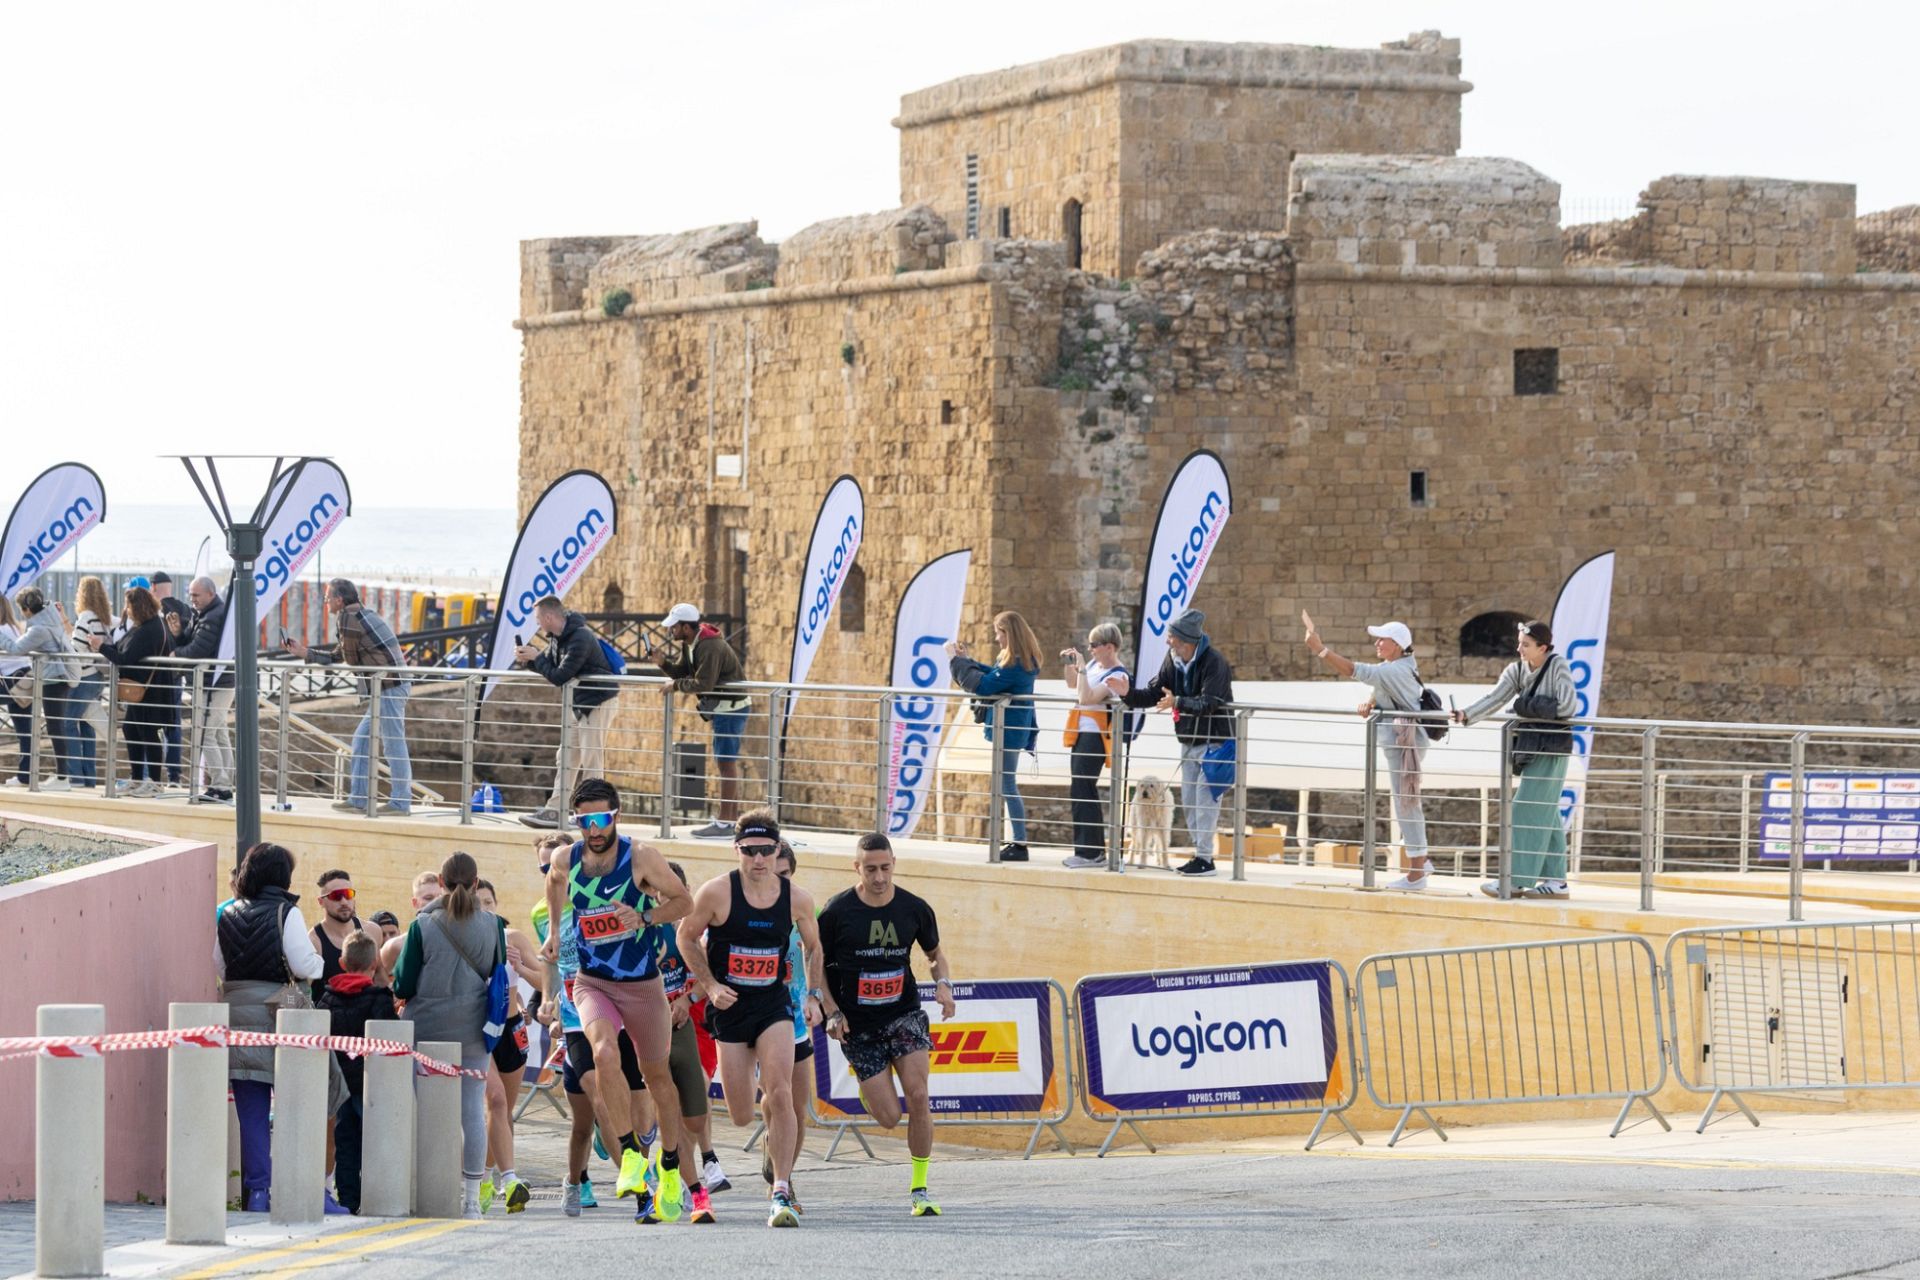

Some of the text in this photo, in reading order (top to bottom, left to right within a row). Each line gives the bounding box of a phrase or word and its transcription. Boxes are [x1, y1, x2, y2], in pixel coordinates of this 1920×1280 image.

[5, 497, 93, 592] ogicom
[255, 493, 339, 593] ogicom
[1147, 491, 1222, 636] Logicom
[506, 508, 605, 627] Logicom
[802, 515, 857, 645] Logicom
[732, 958, 775, 975] 3378
[862, 981, 902, 996] 3657
[1156, 971, 1251, 988] LOGICOM CYPRUS MARATHON
[929, 1030, 996, 1066] HL
[1131, 1010, 1288, 1070] Logicom
[936, 1100, 960, 1110] CYPRUS
[1215, 1091, 1241, 1101] CYPRUS
